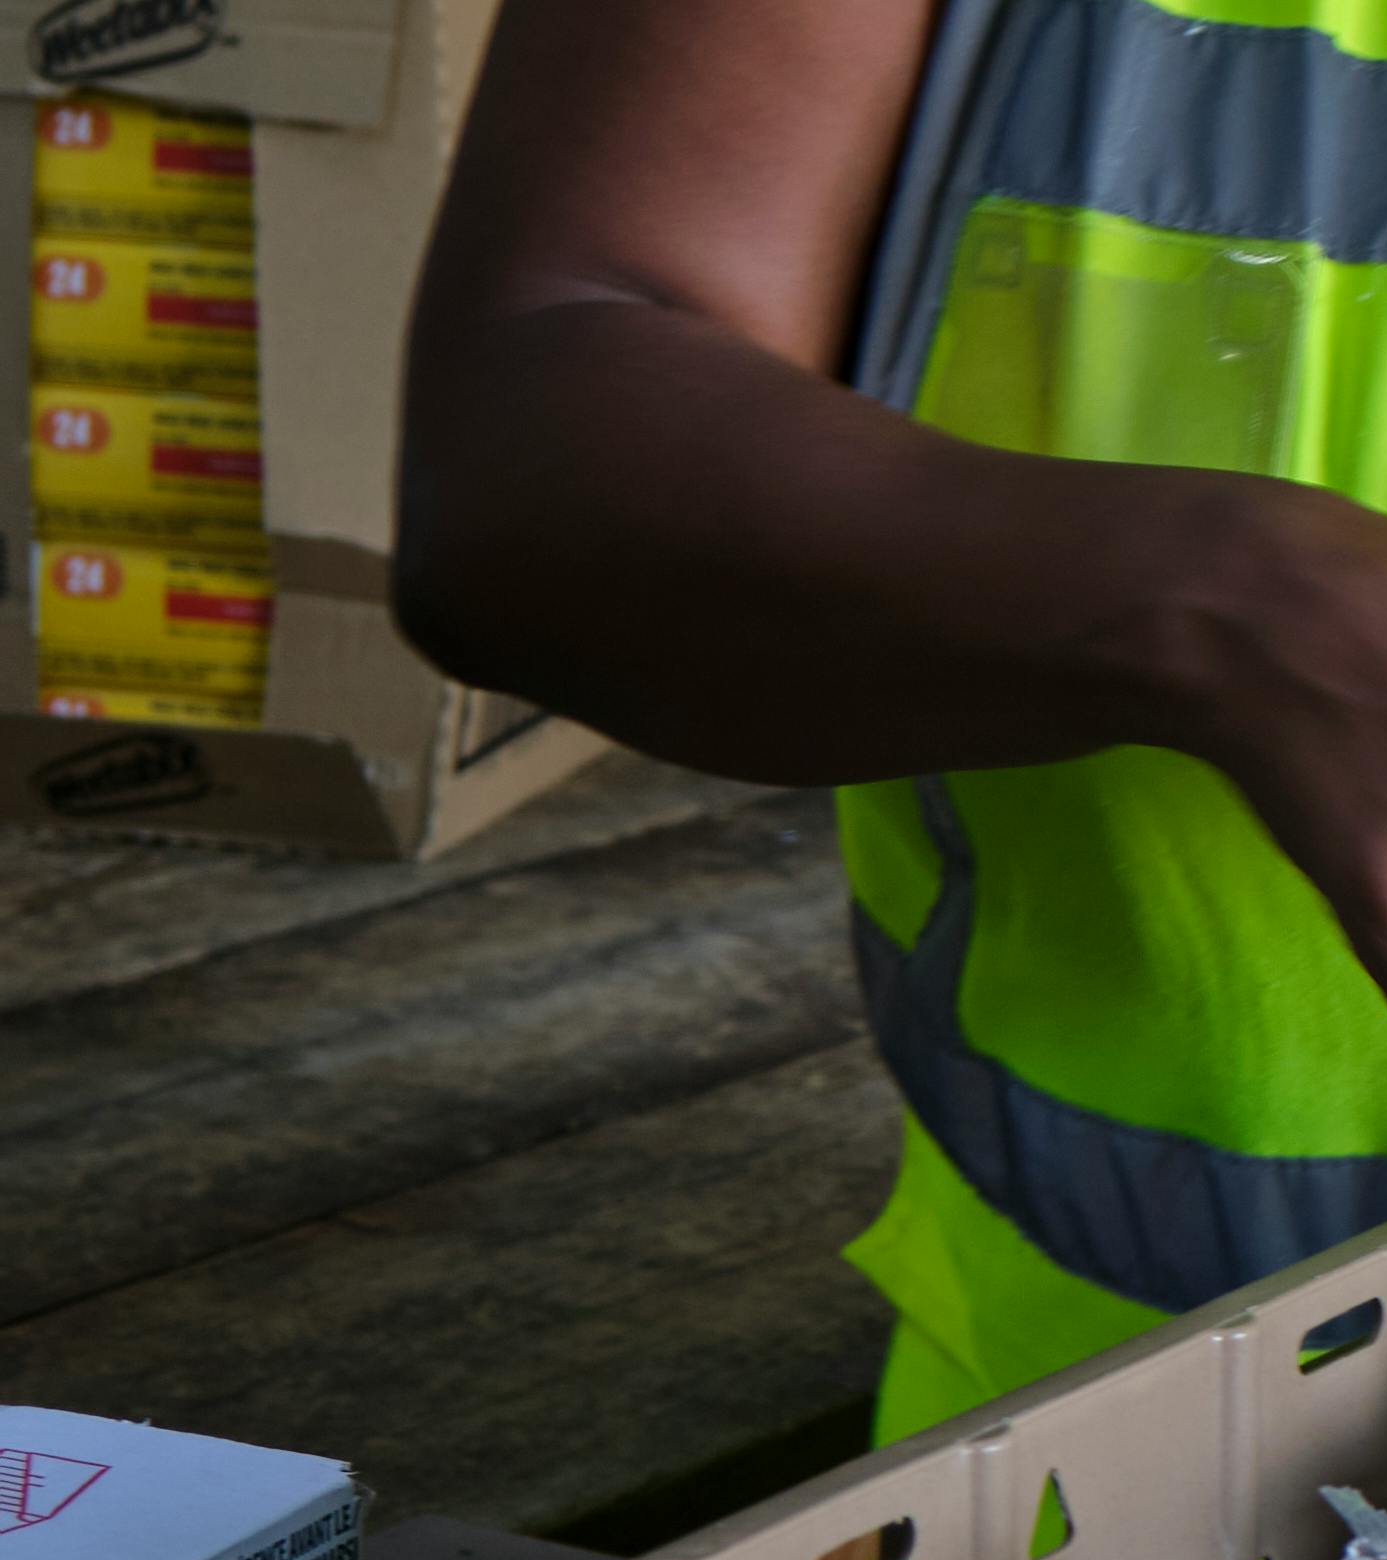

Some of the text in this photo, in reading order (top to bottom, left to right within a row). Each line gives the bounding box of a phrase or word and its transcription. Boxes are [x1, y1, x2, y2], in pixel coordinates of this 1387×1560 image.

[52, 106, 94, 146] 24
[46, 258, 89, 297] 24
[50, 406, 93, 450] 24
[62, 554, 105, 594] 24
[335, 1502, 349, 1538] LE
